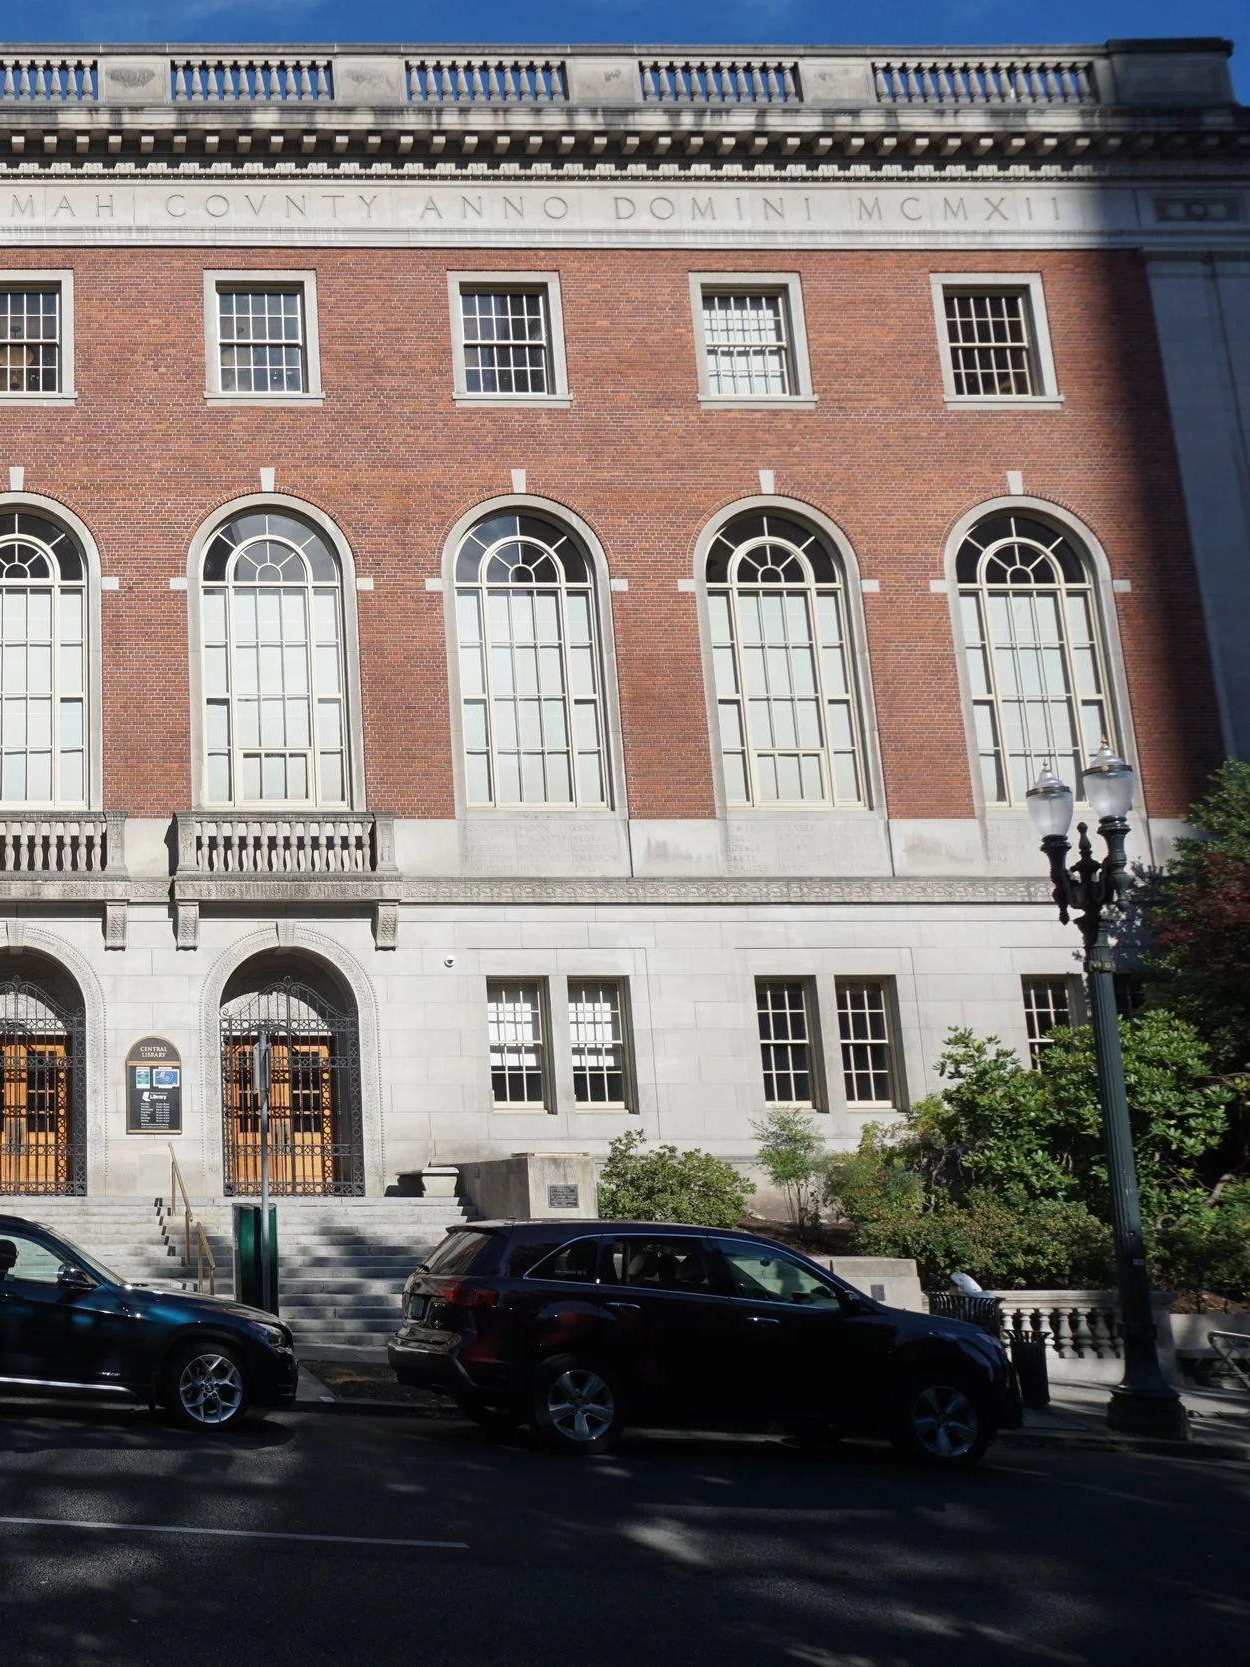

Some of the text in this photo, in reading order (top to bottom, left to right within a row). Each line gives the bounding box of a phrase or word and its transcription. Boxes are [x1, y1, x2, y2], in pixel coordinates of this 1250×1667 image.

[163, 194, 379, 219] COVNTY
[418, 194, 570, 220] ANNO
[613, 195, 813, 221] DOMINI
[856, 196, 1062, 222] MCMXII
